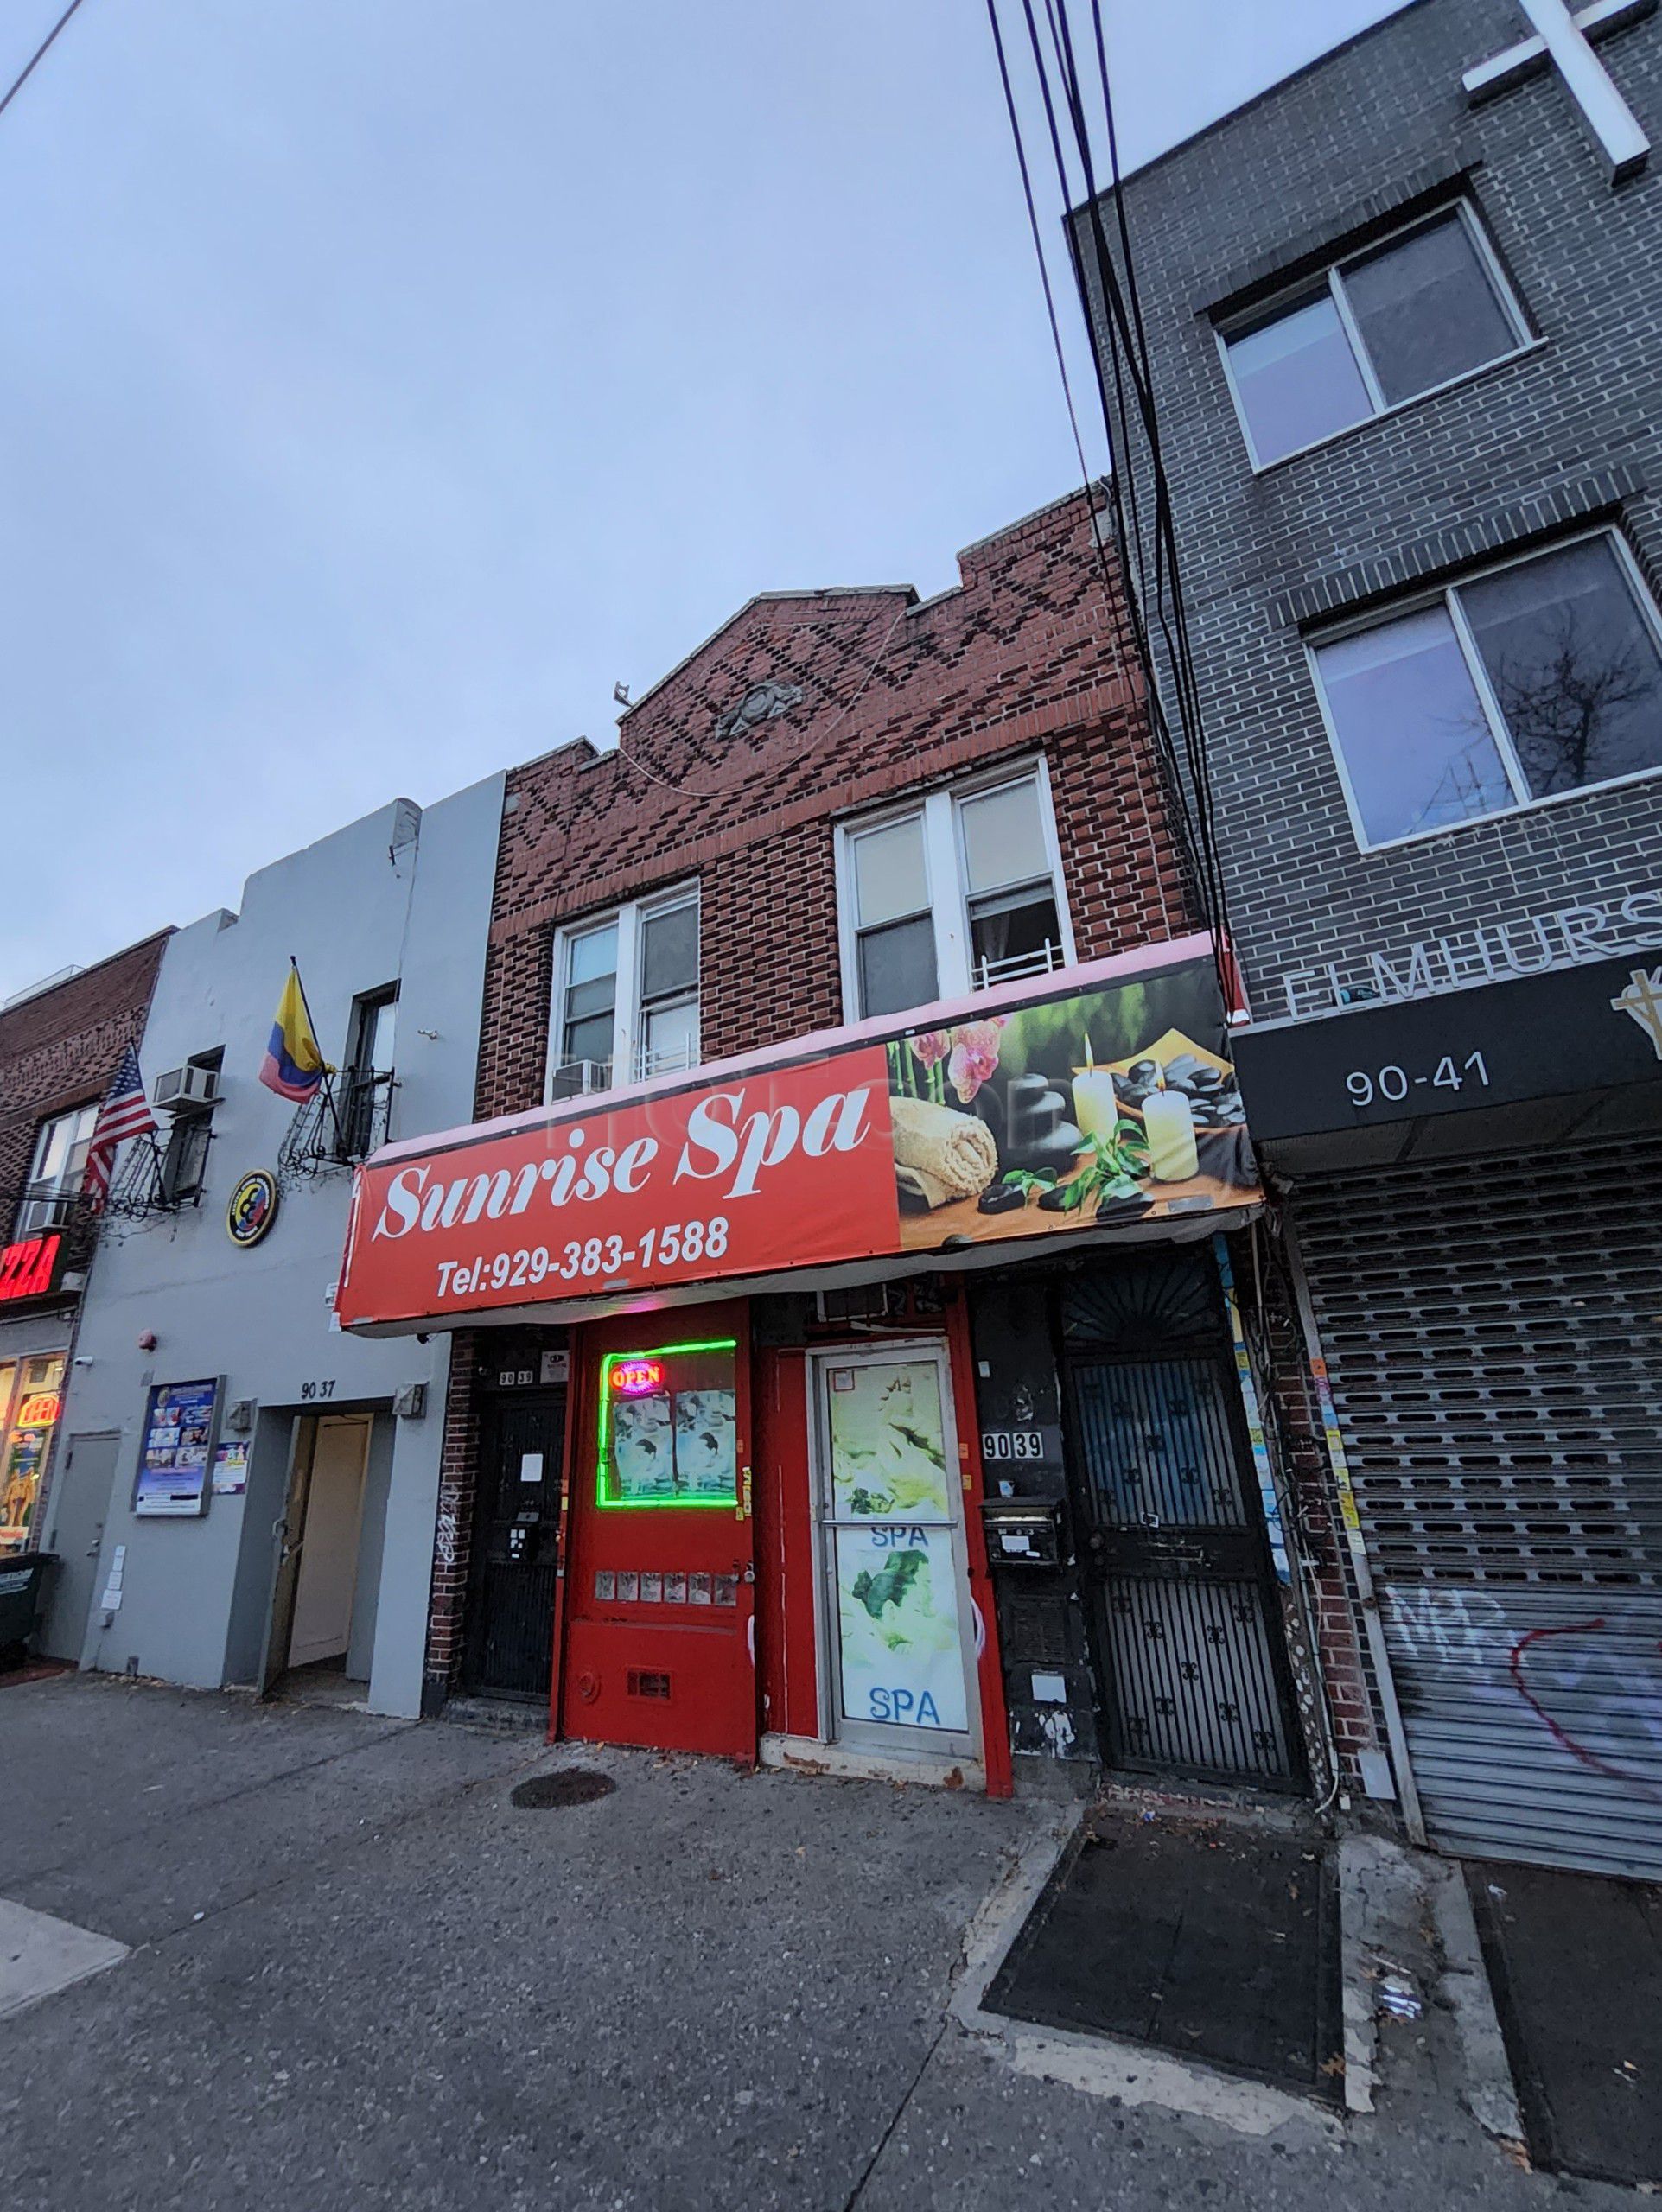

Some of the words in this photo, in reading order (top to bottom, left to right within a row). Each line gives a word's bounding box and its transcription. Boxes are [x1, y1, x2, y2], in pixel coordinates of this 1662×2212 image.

[1345, 1050, 1492, 1107] 90-41
[372, 1128, 659, 1242] Sunrise
[673, 1087, 872, 1200] Spa
[436, 1217, 729, 1298] Tel:929-383-1588
[613, 1366, 660, 1388] OPEN
[871, 1526, 929, 1548] SPA
[869, 1687, 940, 1726] SPA
